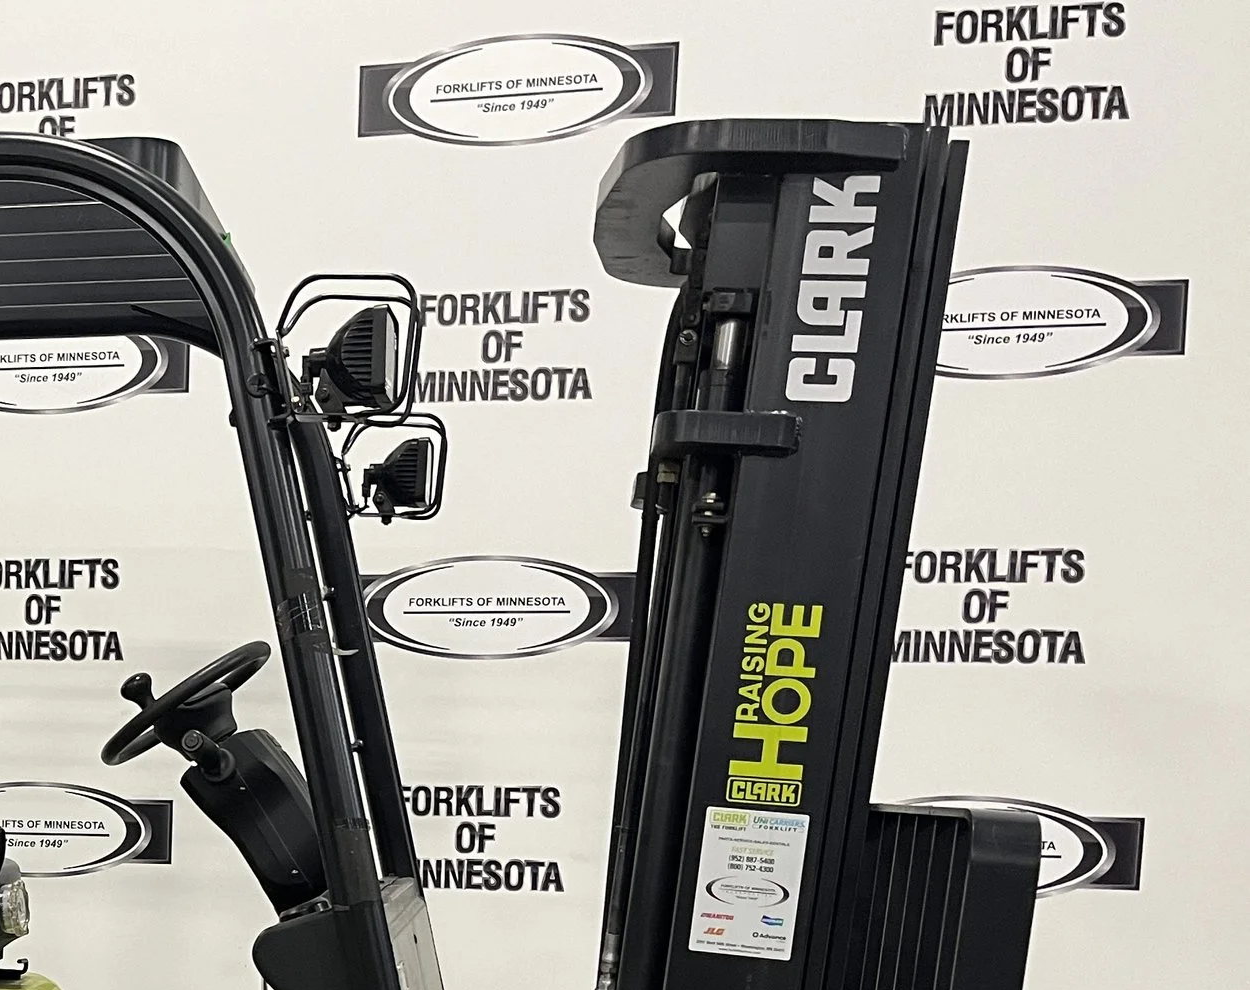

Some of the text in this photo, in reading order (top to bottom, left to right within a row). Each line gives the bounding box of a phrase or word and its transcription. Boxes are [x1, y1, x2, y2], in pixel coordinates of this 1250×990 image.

[934, 2, 1125, 46] FORKLIFTS
[1005, 47, 1051, 83] OF
[436, 73, 598, 95] FORKLIFTS OF MINNESOTA
[924, 86, 1129, 126] MINNESOTA
[785, 175, 881, 402] CLARK
[419, 289, 590, 327] FORKLIFTS
[941, 308, 1101, 325] RKLIFTS OF MINNESOTA
[39, 352, 54, 363] OF
[56, 350, 120, 362] MINNESOTA
[482, 330, 523, 363] OF
[414, 367, 592, 403] MINNESOTA
[25, 594, 61, 625] OF
[408, 596, 566, 607] FORKLIFTS OF MINNESOTA
[962, 589, 1009, 623] OF
[736, 602, 771, 721] RAISING
[891, 629, 1085, 664] MINNESOTA
[728, 603, 823, 780] HOPE
[731, 781, 796, 803] CLARK
[26, 819, 41, 829] OF
[44, 820, 106, 830] MINNESOTA
[455, 822, 496, 853] OF
[417, 859, 565, 892] NNESOTA
